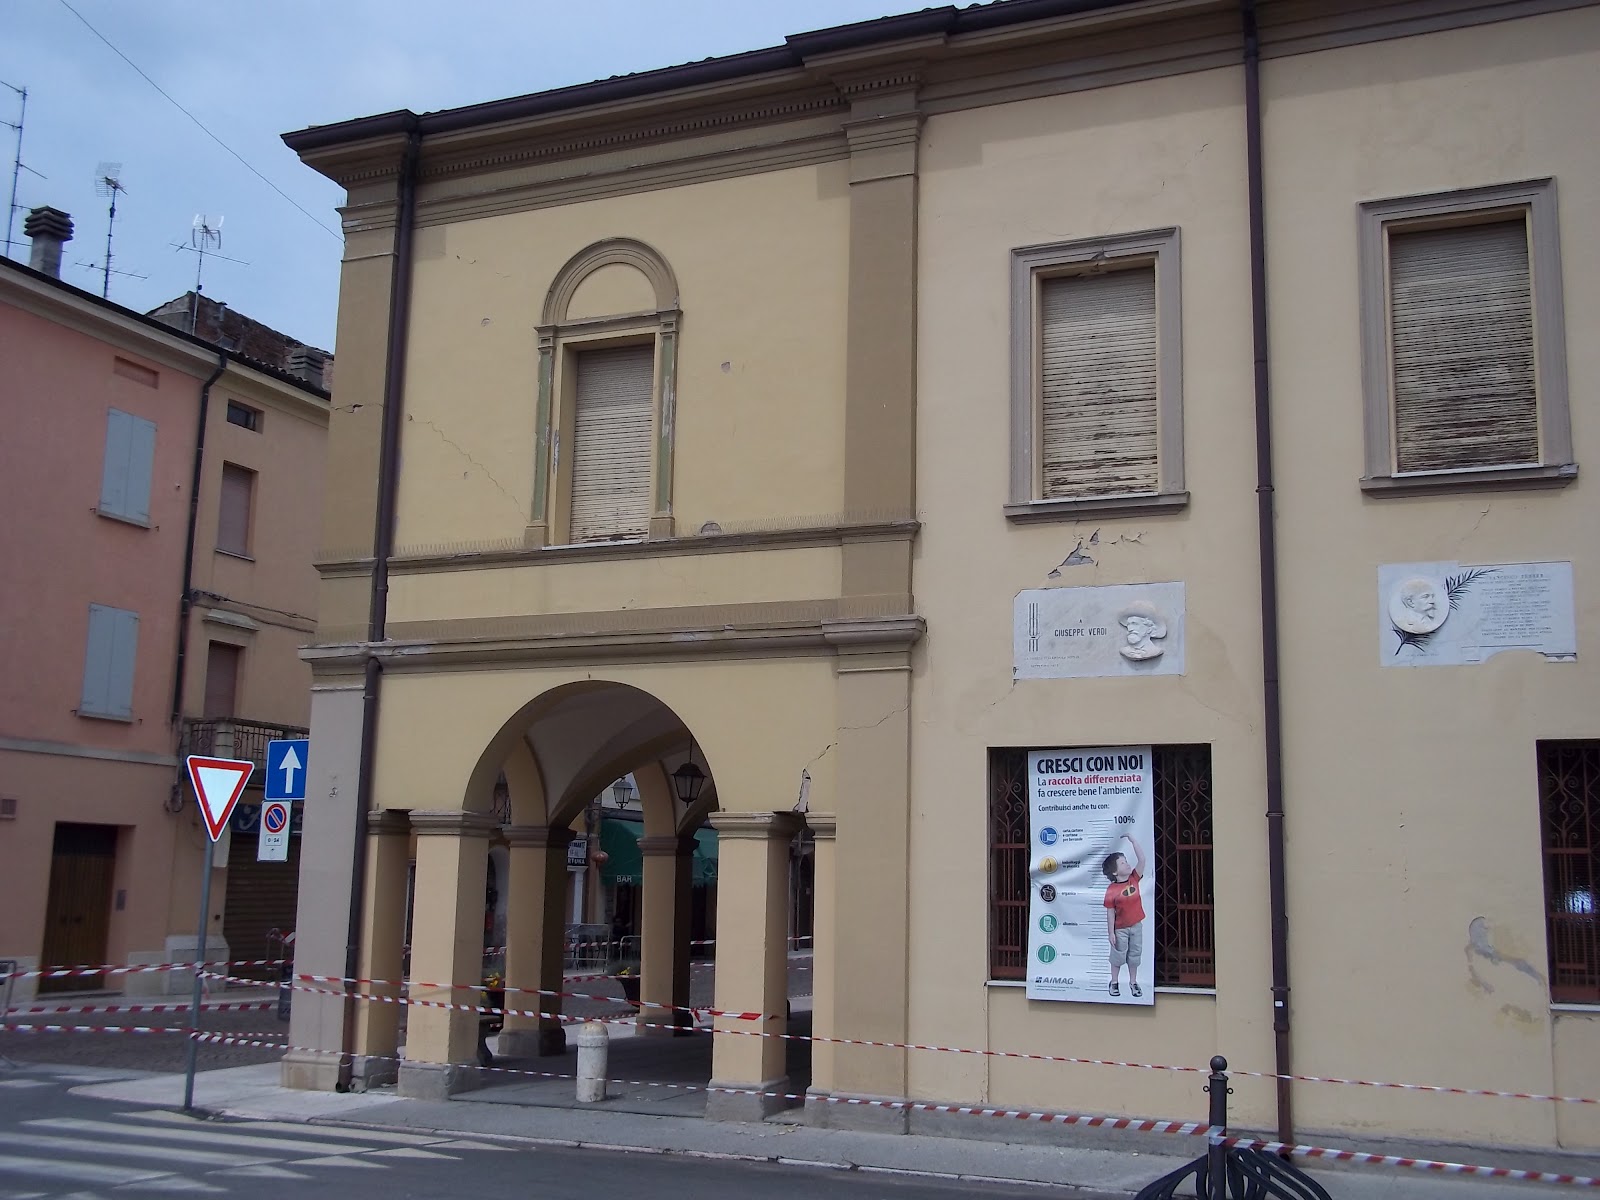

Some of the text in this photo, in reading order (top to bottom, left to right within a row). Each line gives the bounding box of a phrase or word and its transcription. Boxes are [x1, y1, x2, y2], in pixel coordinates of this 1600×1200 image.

[1054, 627, 1107, 637] GIUSEPPE VERDI
[1037, 755, 1143, 774] CRESCI CON NOI
[1038, 773, 1142, 786] La raccolta differenziata
[1038, 786, 1142, 797] fa crescere bene l'ambiente.
[1038, 804, 1071, 812] Contribuisci
[1114, 816, 1135, 824] 100%
[616, 875, 632, 883] BAR
[1042, 977, 1074, 985] AIMAG
